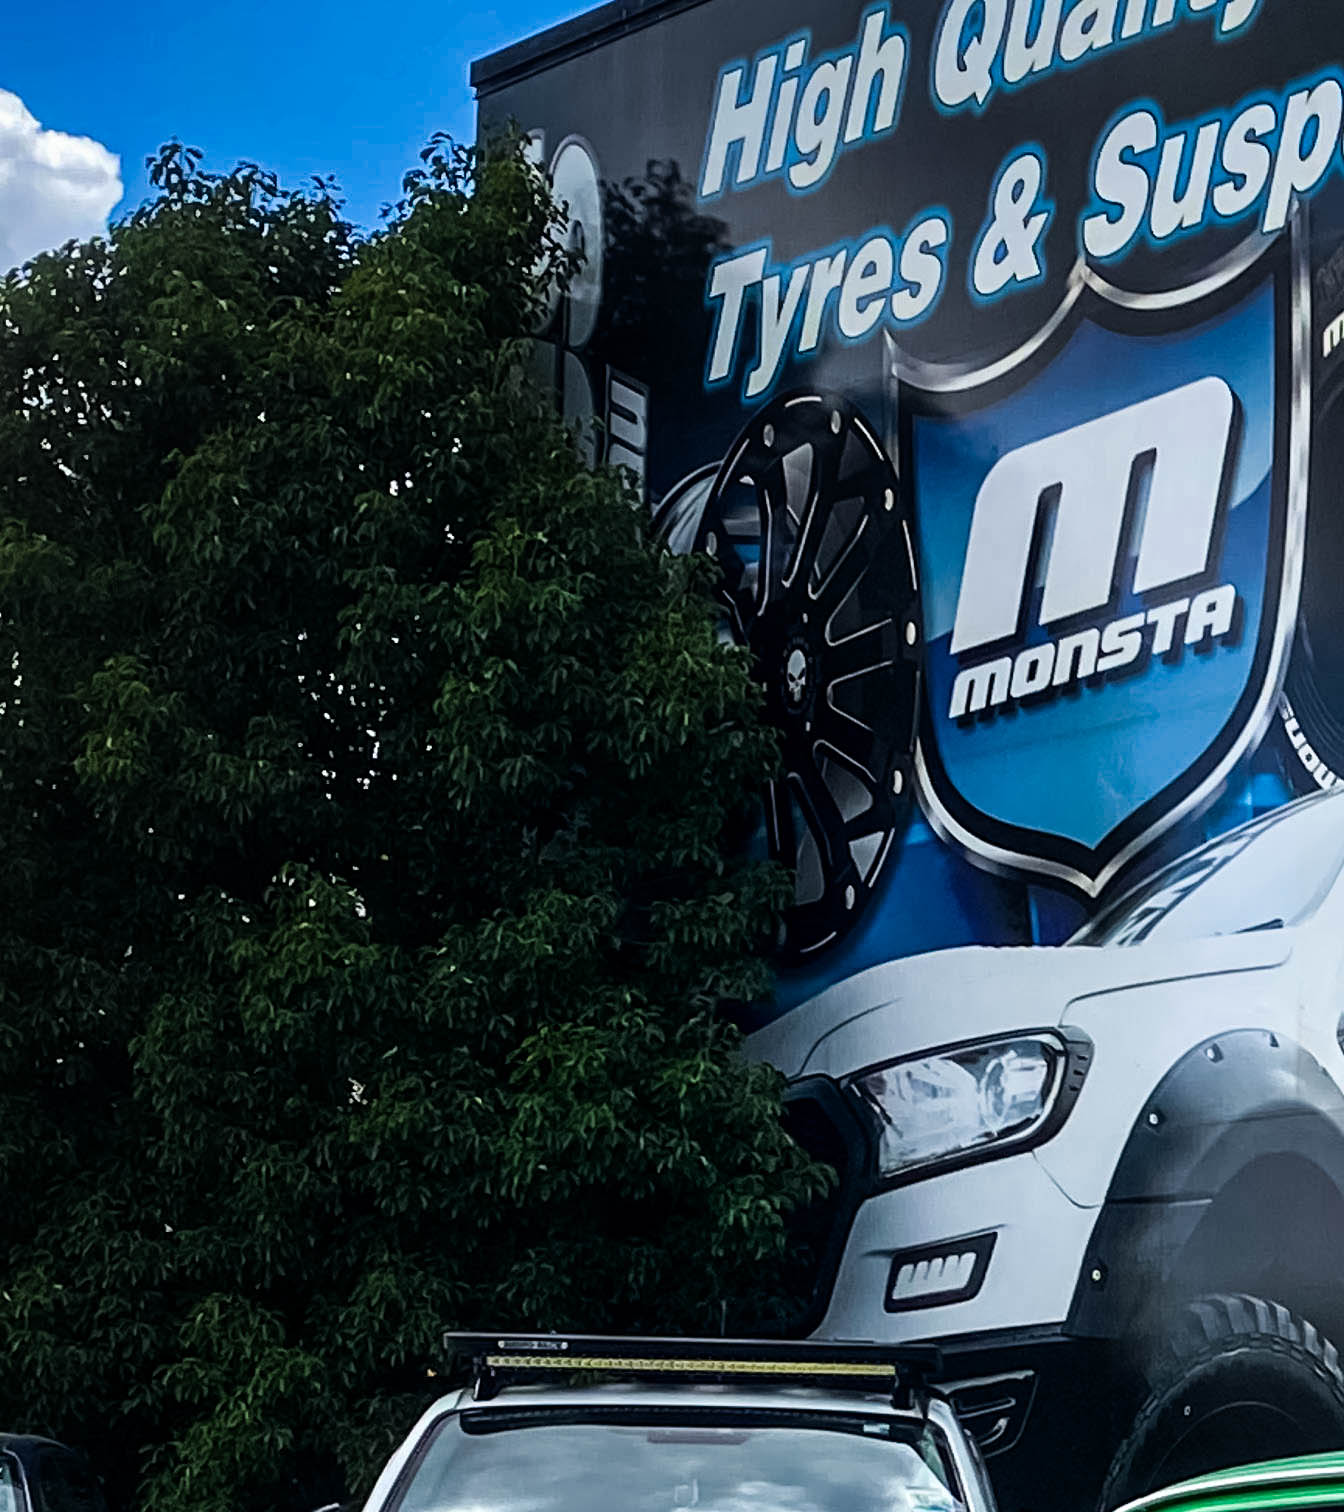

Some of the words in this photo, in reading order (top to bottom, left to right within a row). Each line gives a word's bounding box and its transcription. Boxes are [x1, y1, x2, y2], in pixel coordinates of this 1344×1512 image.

[701, 9, 905, 197] High
[708, 216, 948, 397] Tyres
[973, 153, 1050, 295] &
[948, 583, 1237, 719] MONSTA
